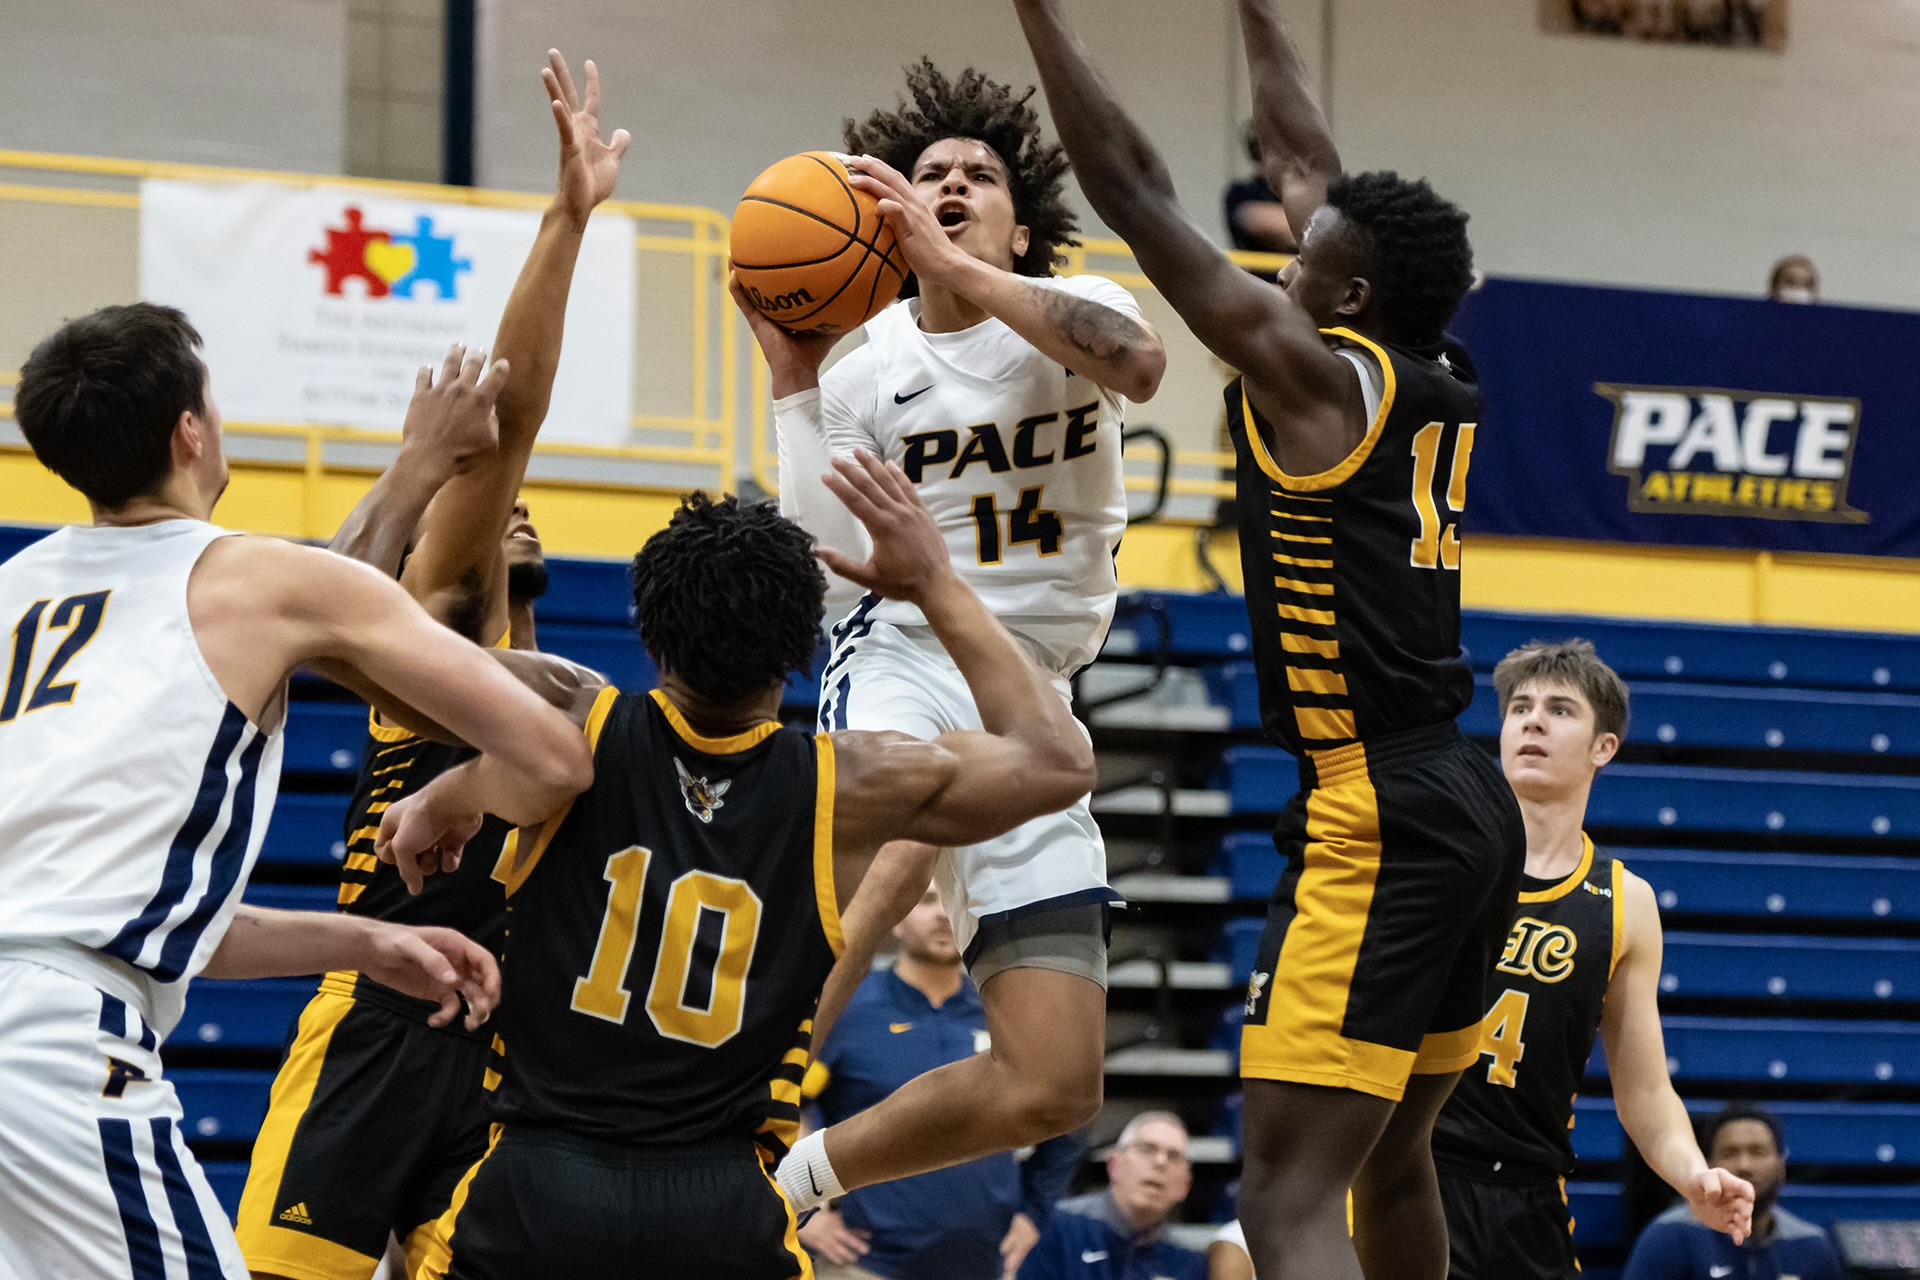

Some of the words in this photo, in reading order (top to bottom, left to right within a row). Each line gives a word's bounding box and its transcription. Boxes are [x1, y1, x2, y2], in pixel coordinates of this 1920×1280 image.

[744, 286, 817, 312] lson
[901, 401, 1099, 484] PACE
[1613, 391, 1855, 479] PACE
[970, 485, 1065, 567] 14
[1642, 471, 1835, 512] ATHLETICS
[0, 588, 114, 727] 12
[570, 844, 764, 1049] 10
[1496, 916, 1578, 984] IC
[279, 1213, 313, 1226] adidas
